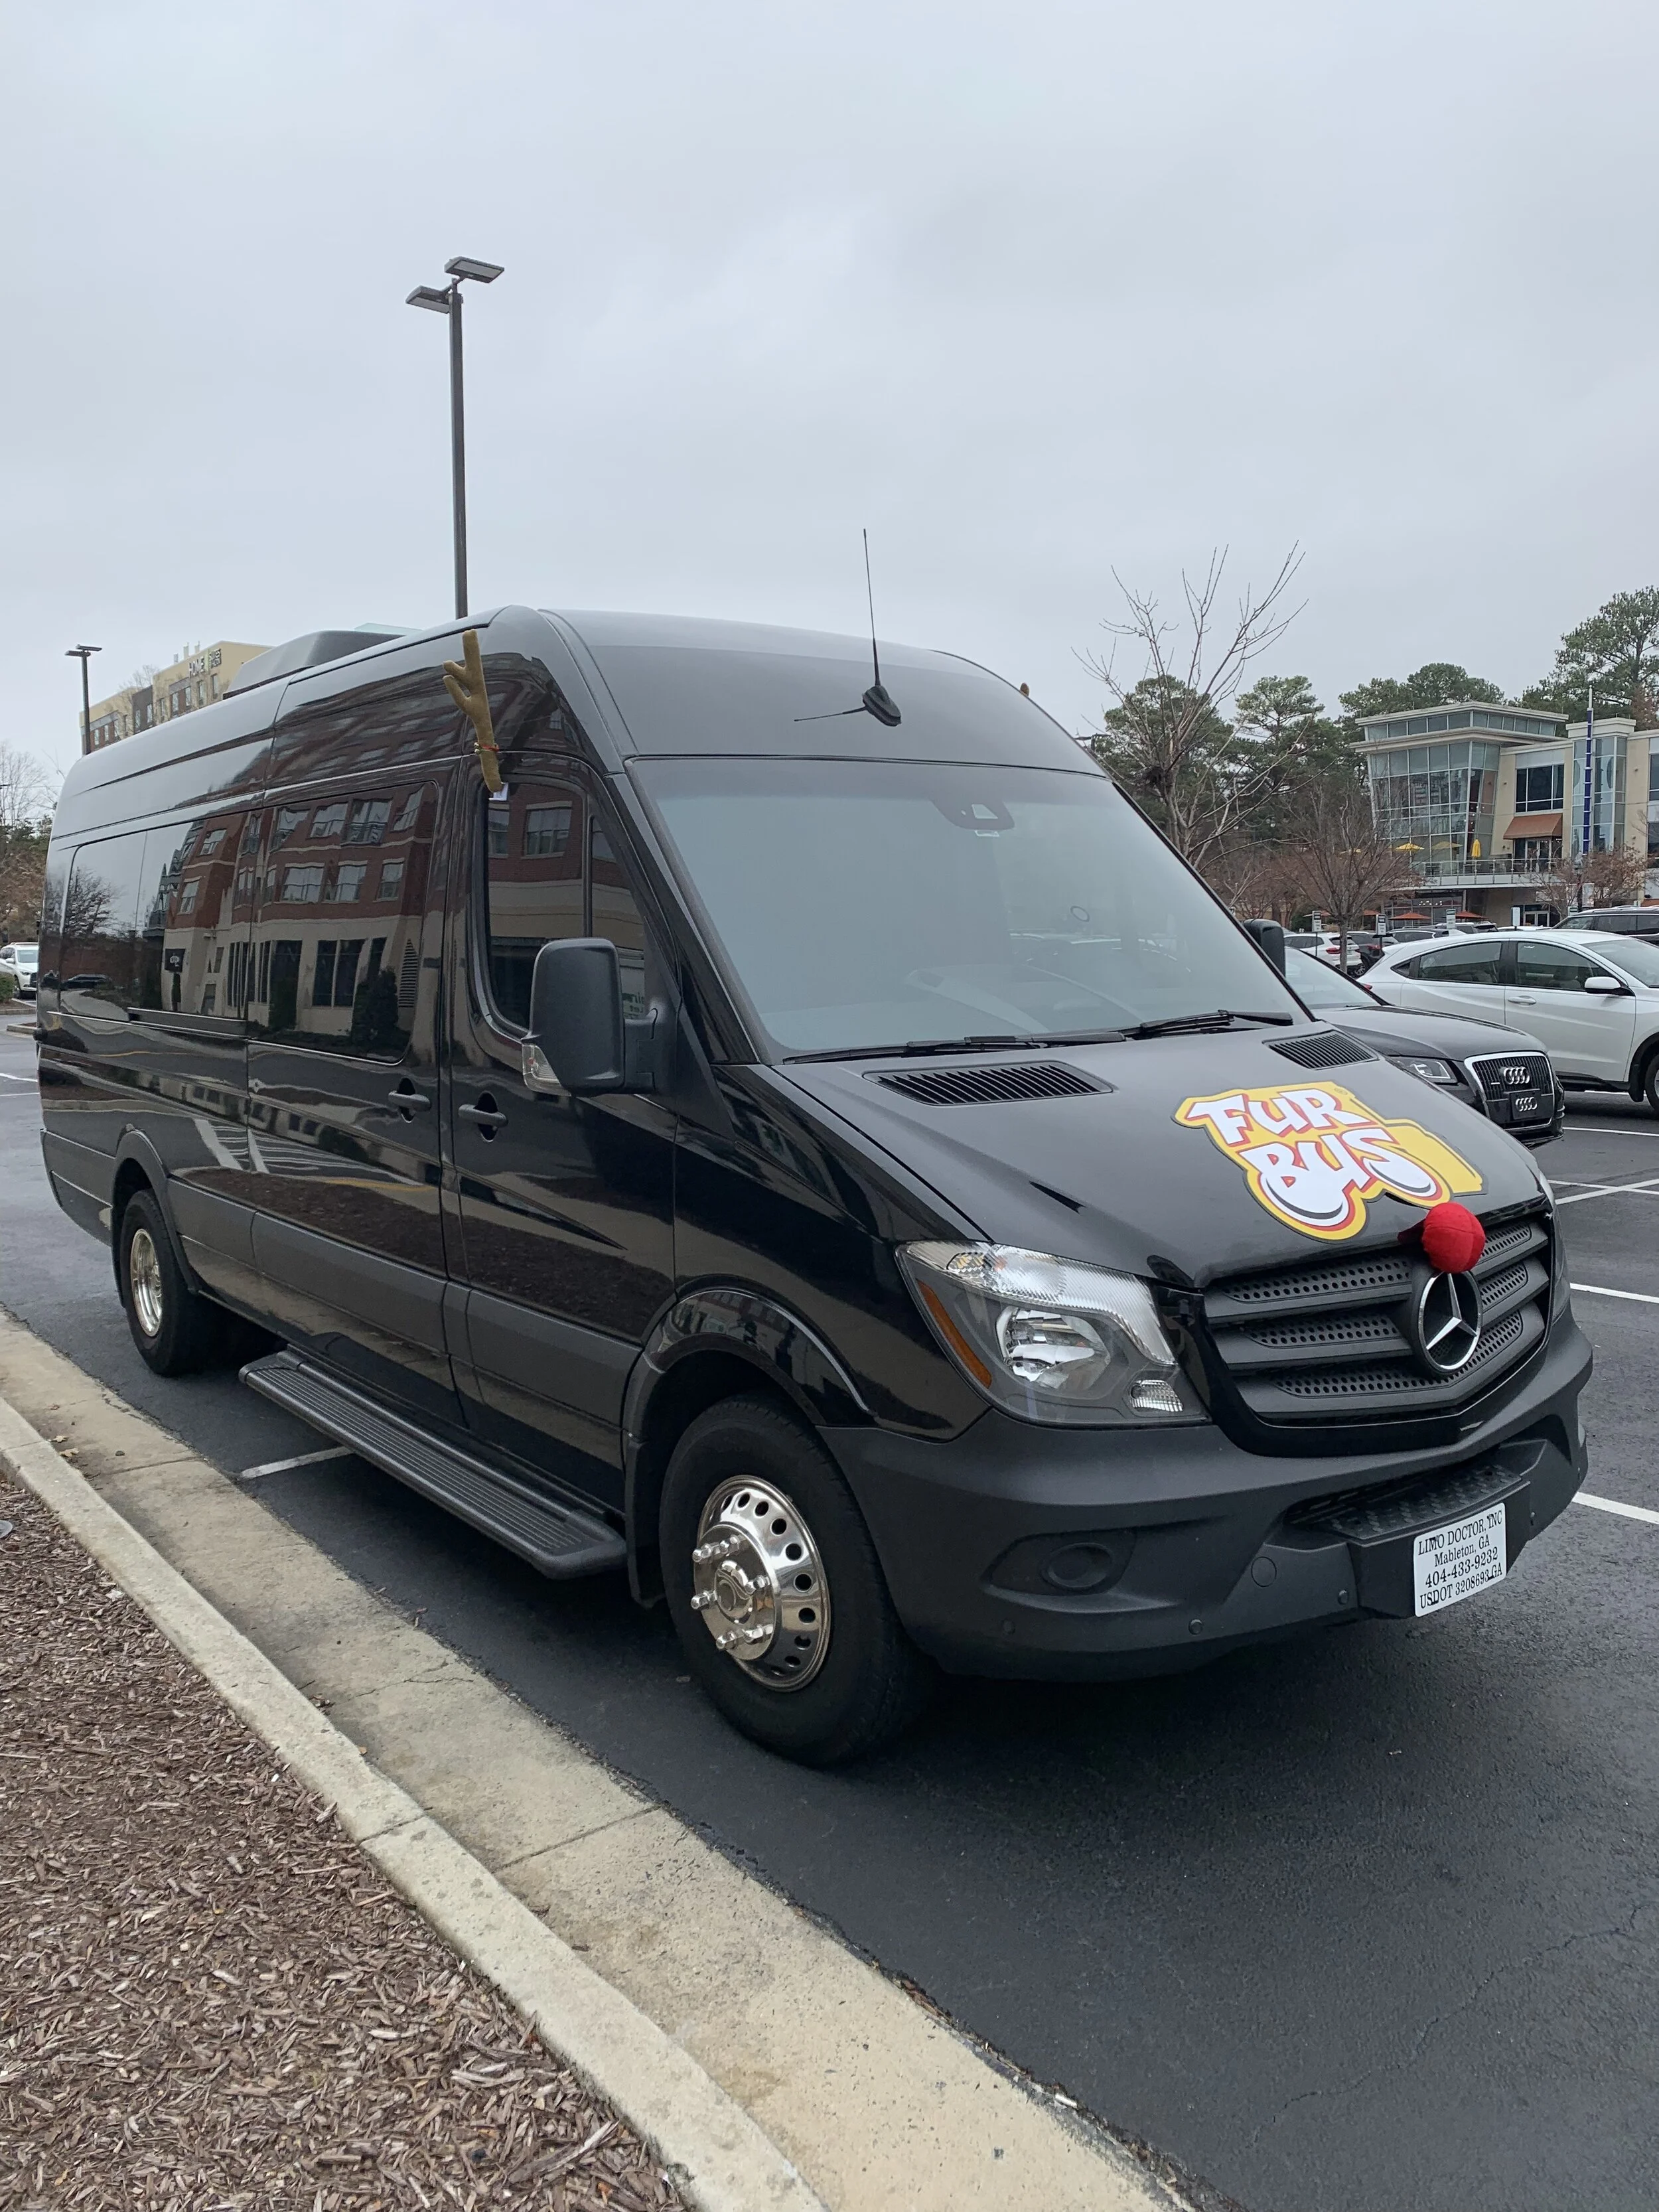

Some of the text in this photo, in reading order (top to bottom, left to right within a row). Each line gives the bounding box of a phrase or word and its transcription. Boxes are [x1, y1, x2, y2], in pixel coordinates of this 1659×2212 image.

[1187, 1088, 1376, 1145] FUR
[1237, 1128, 1440, 1230] BUS
[1418, 1534, 1445, 1555] LIMO
[1447, 1518, 1486, 1546] DOCTOR,
[1434, 1534, 1490, 1567] Mableton, GA
[1420, 1584, 1453, 1609] USDOT
[1491, 1562, 1502, 1580] GA
[1425, 1546, 1498, 1588] 404-433-9232
